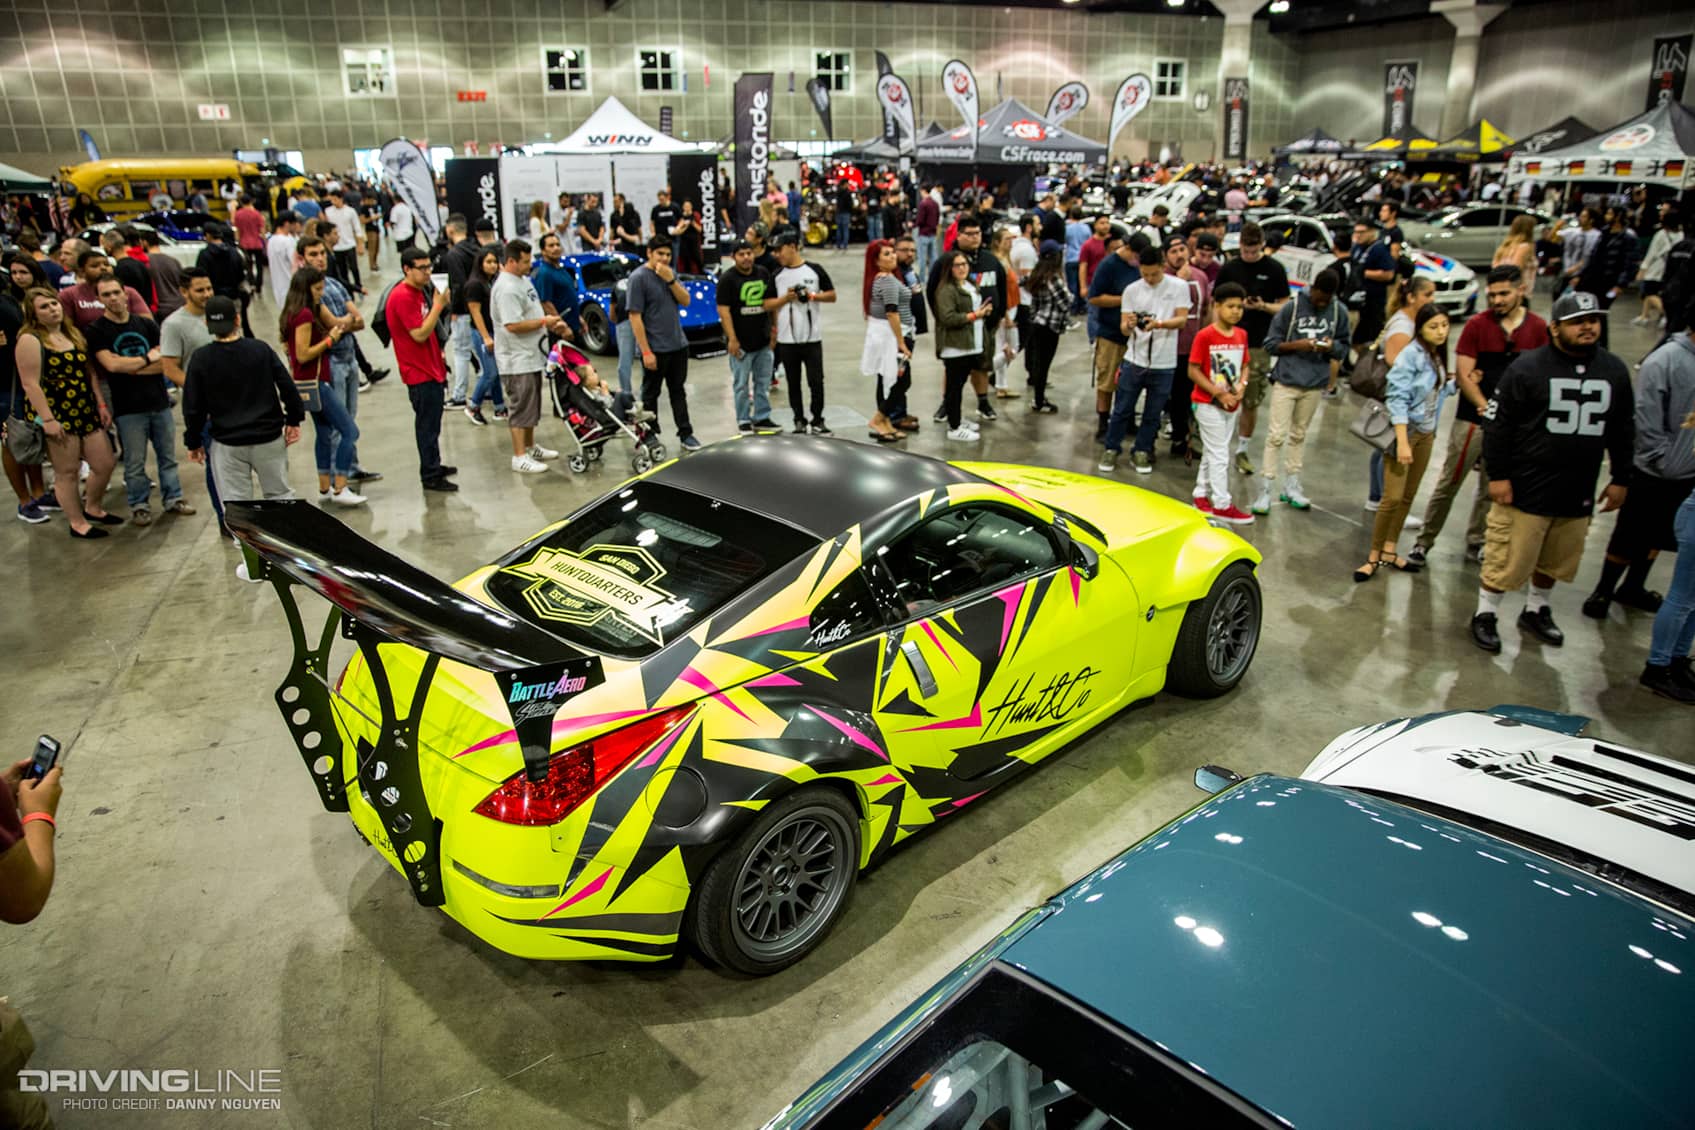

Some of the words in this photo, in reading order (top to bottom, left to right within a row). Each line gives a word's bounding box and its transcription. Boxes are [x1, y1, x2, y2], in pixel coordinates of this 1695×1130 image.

[587, 134, 653, 145] WINN
[1000, 145, 1086, 163] CSFrace.com
[1546, 377, 1612, 436] 52
[598, 554, 621, 565] SAN
[615, 558, 640, 575] DIEGO
[551, 561, 644, 605] HUNTQUARTERS
